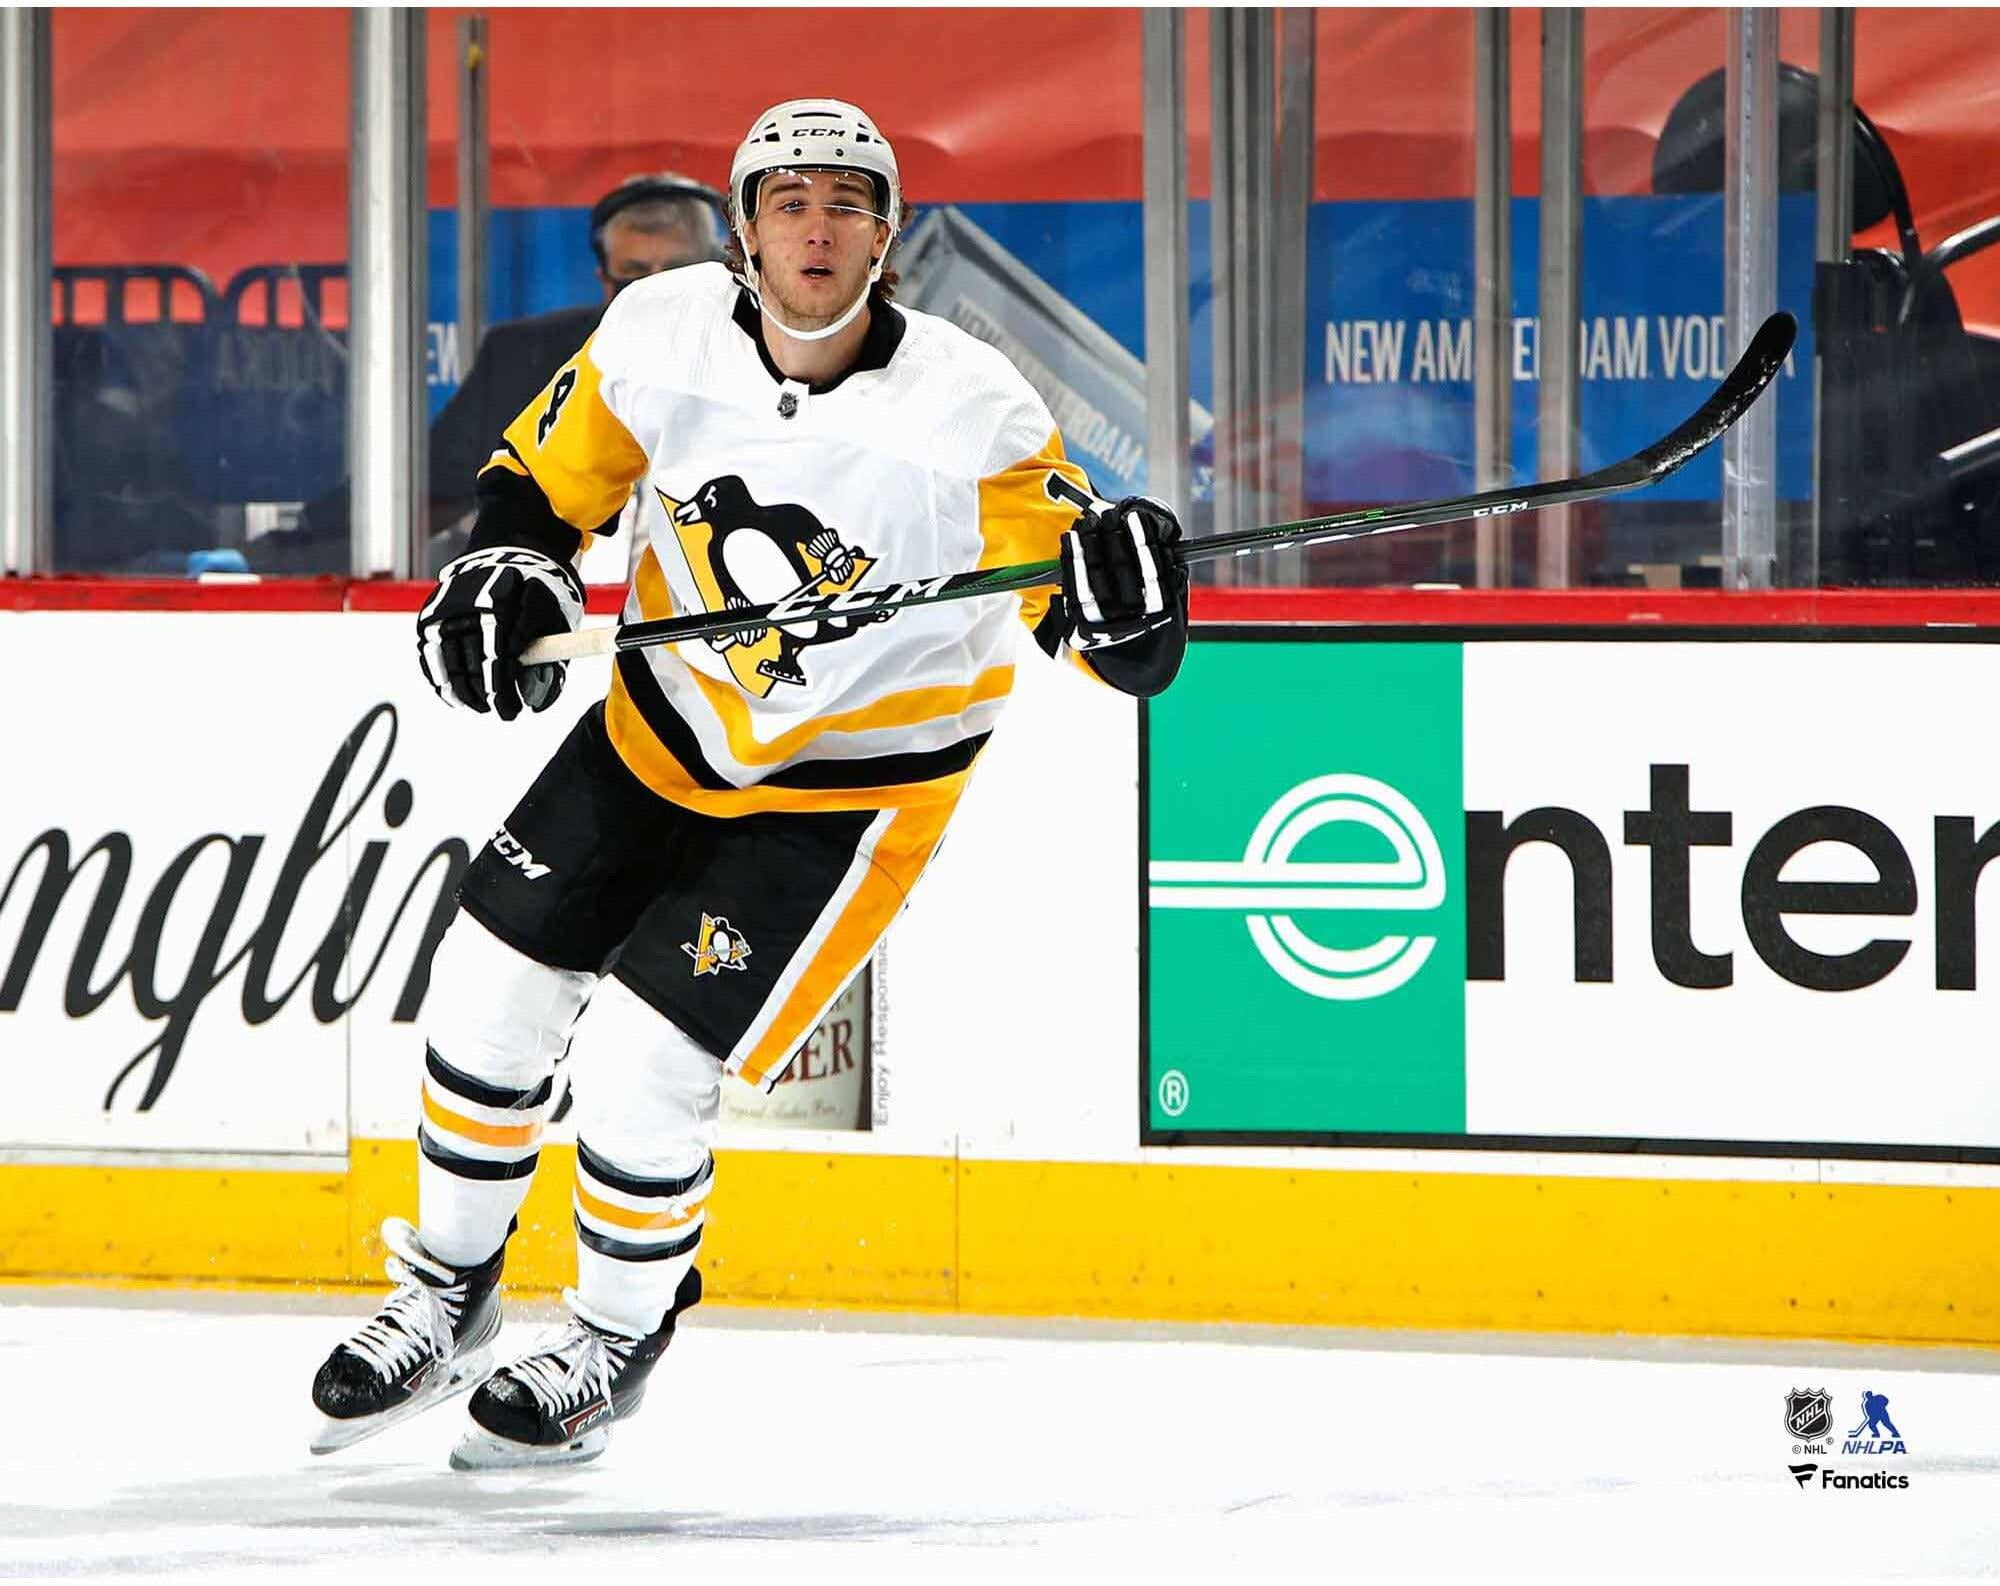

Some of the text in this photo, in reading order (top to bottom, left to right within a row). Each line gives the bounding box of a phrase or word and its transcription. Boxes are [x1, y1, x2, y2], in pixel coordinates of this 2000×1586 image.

[791, 128, 846, 137] CCM
[1324, 314, 1797, 384] NEW AMEAM VOD
[1472, 501, 1529, 517] CCM
[766, 574, 955, 621] CCM
[492, 829, 552, 880] CM
[873, 1065, 890, 1126] Enjoy
